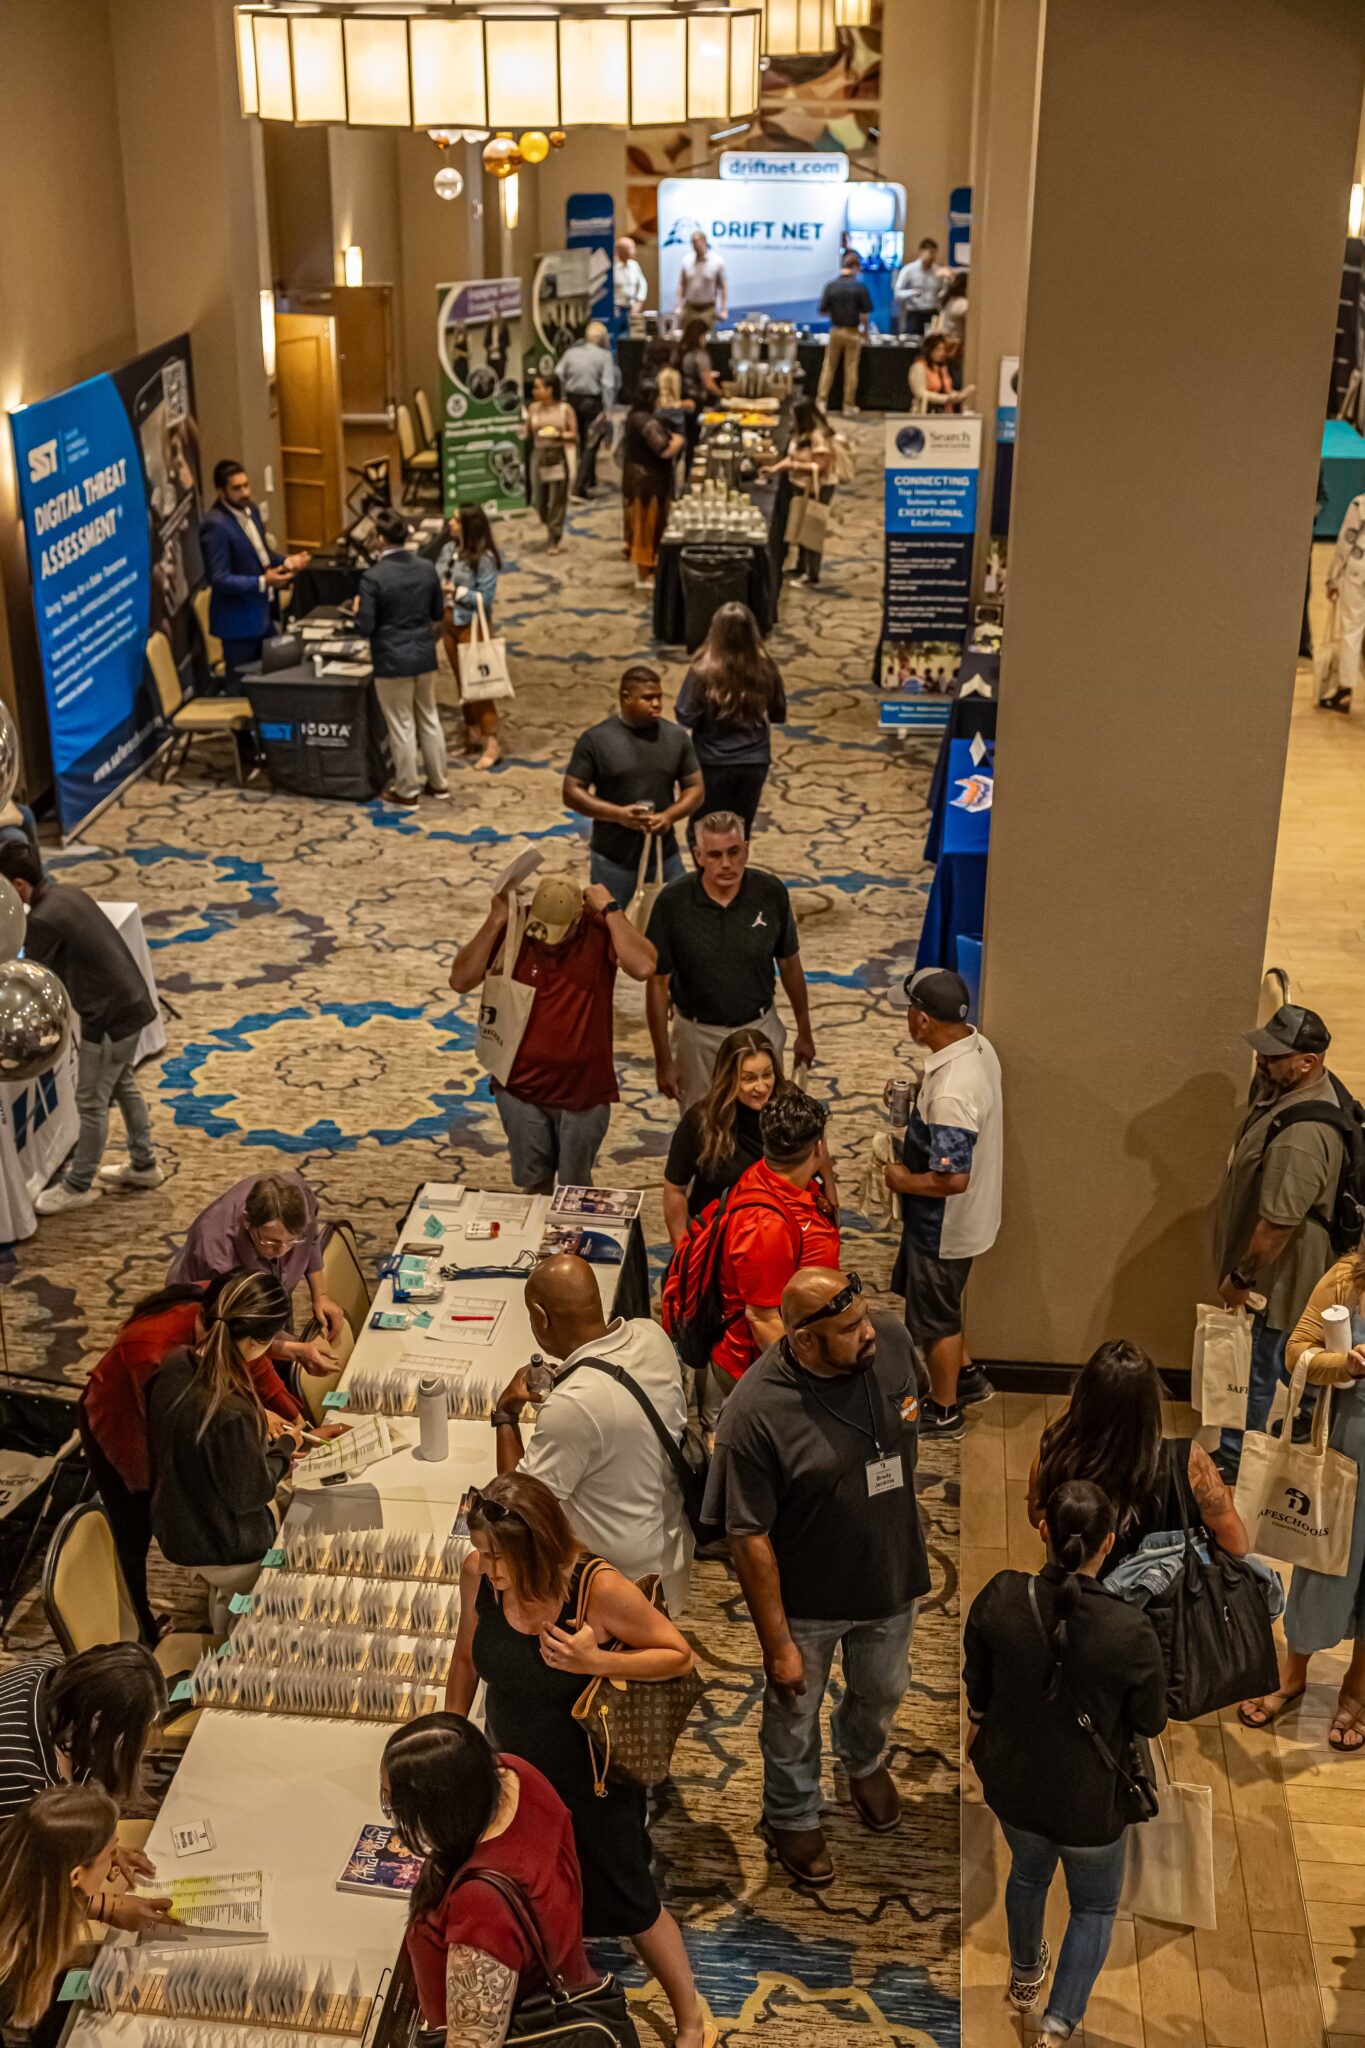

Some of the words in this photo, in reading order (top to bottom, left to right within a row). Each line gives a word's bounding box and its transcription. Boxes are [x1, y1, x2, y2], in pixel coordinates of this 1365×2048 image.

[729, 158, 840, 175] driftnet.com
[712, 220, 775, 239] DRIFT
[782, 222, 824, 240] NET
[894, 475, 970, 487] CONNECTING
[34, 485, 83, 536] DIGITAL
[82, 458, 126, 506] THREAT
[898, 508, 964, 518] EXCEPTIONAL
[41, 507, 117, 580] ASSESSMENT
[351, 1830, 392, 1881] Anaheim
